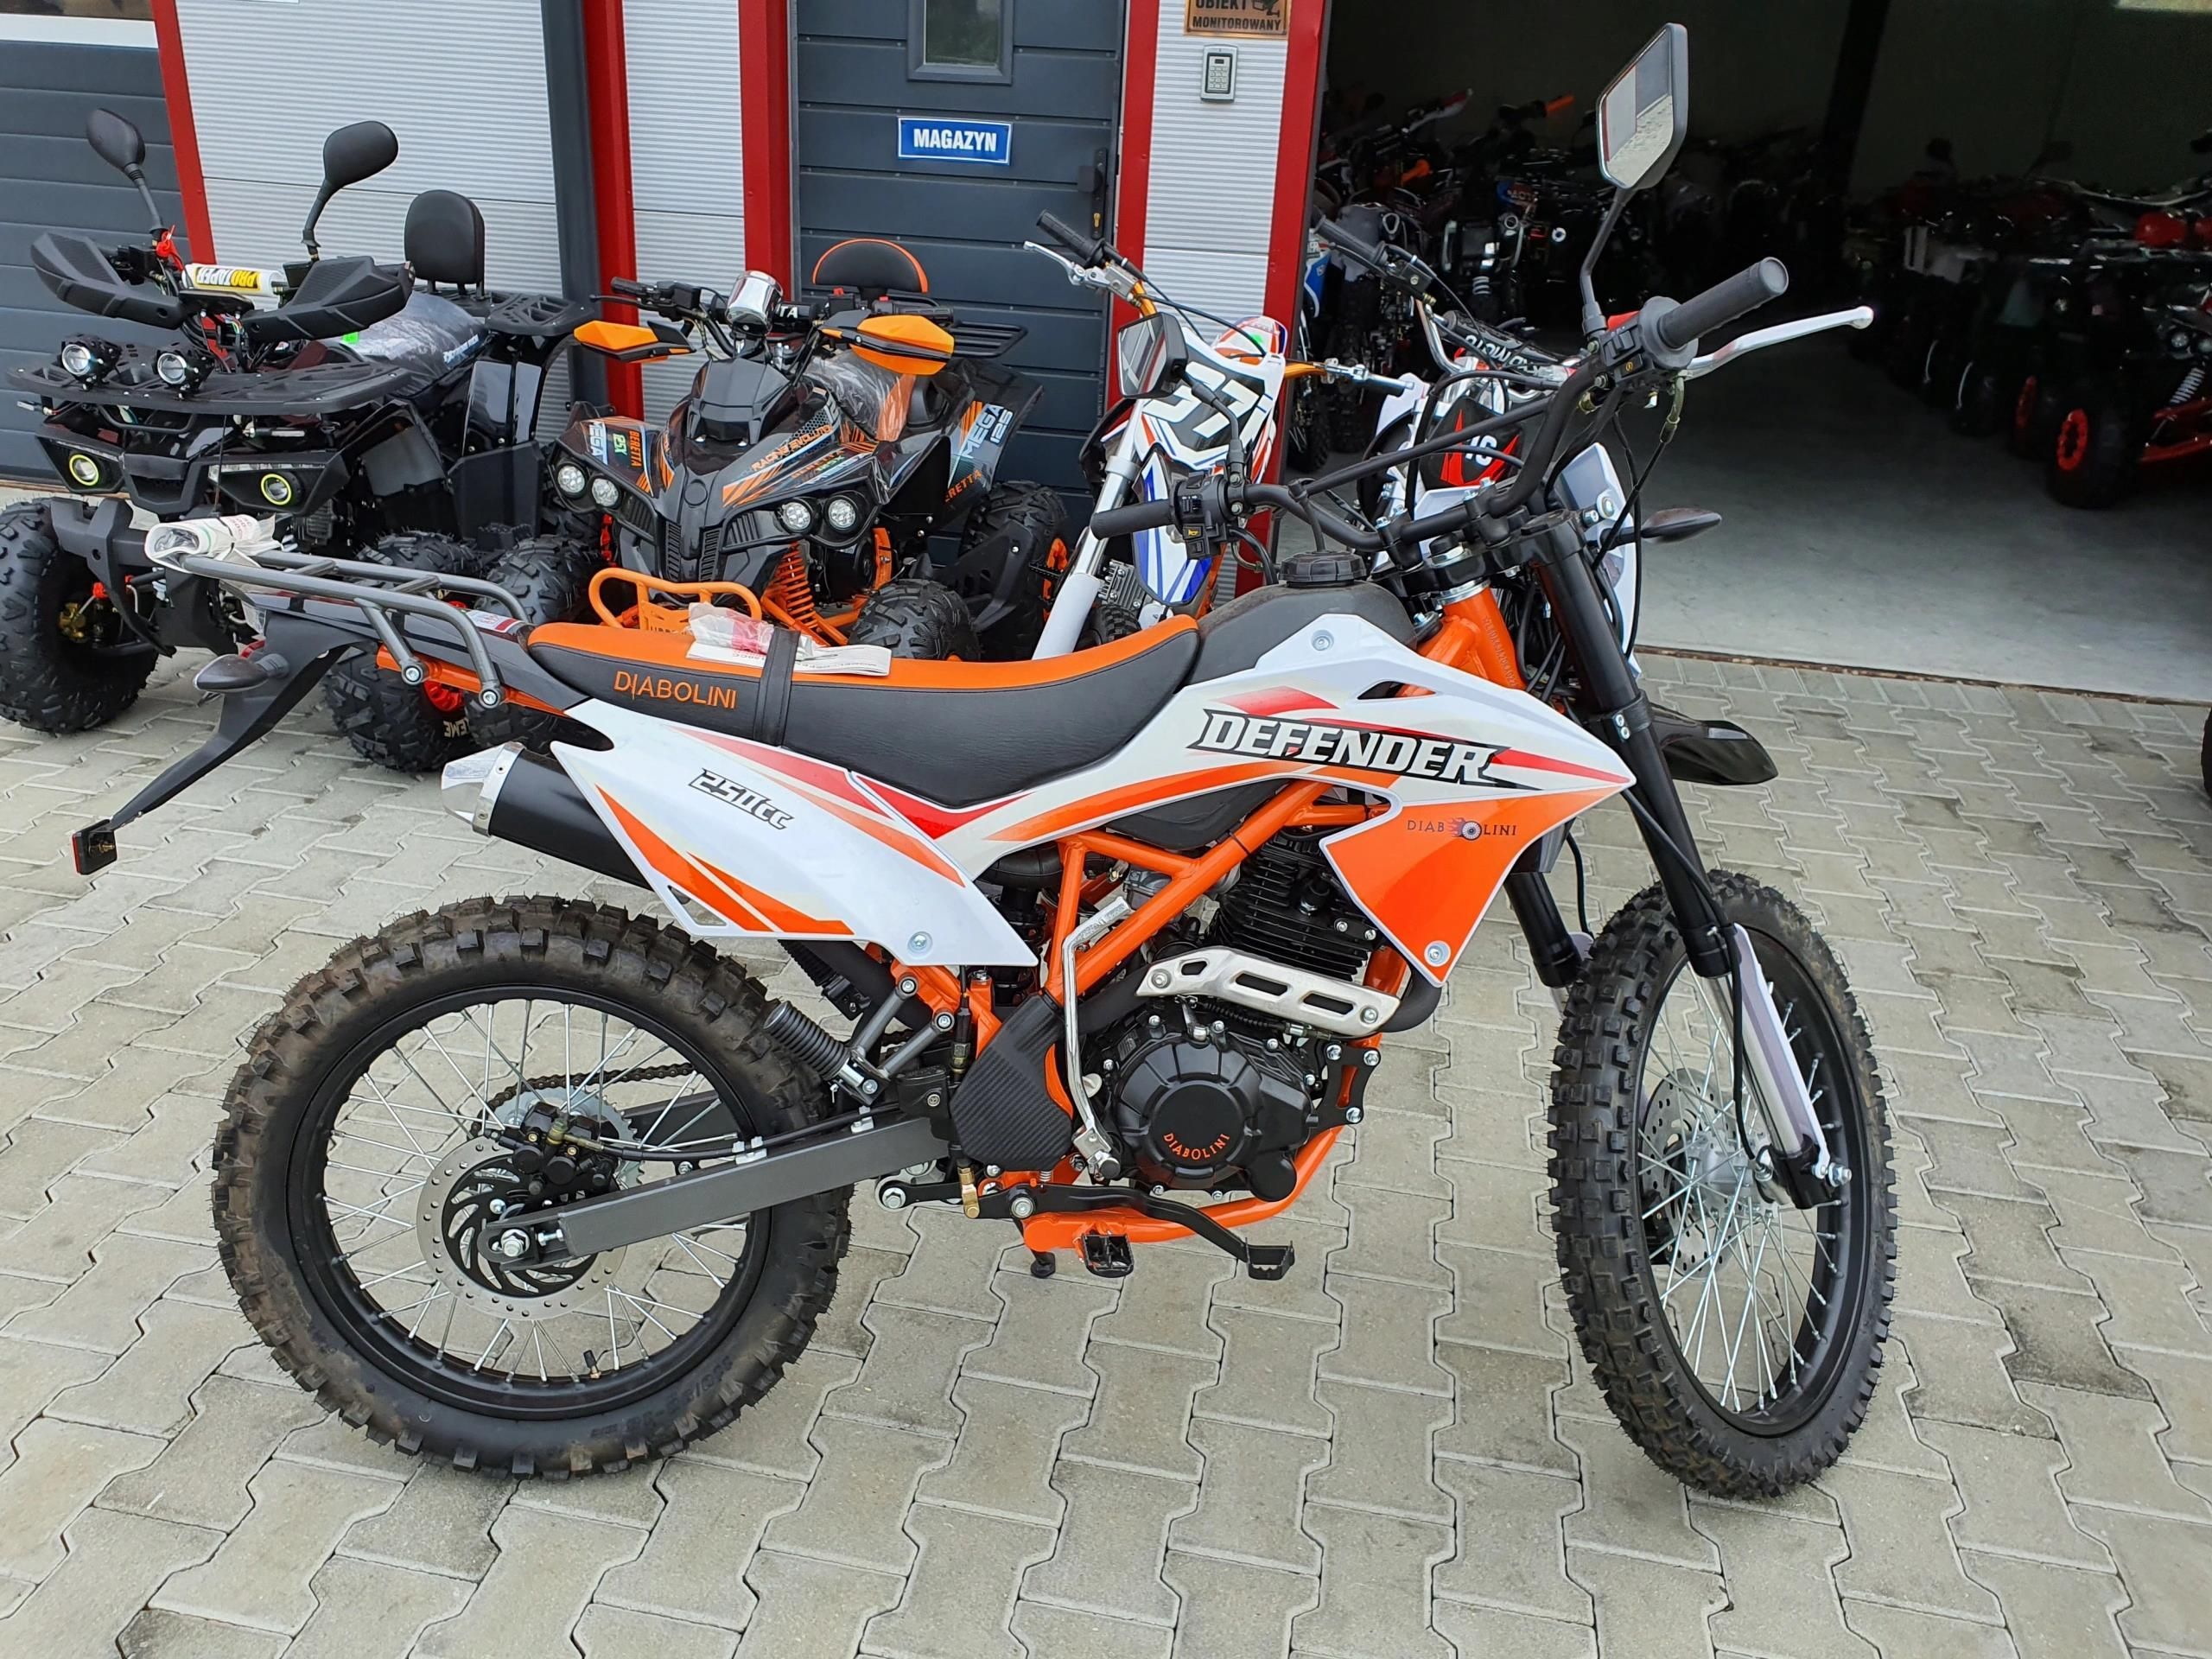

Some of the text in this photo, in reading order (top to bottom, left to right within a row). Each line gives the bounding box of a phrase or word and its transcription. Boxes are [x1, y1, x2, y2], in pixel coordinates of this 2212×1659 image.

[1192, 16, 1281, 31] MONITOROWANY
[913, 128, 997, 152] MAGAZYN
[961, 403, 1004, 459] MEGA
[989, 409, 1014, 443] 125
[628, 430, 643, 467] BERETTA
[613, 671, 738, 709] DIABOLINI
[1189, 709, 1510, 787] DEFENDER
[1163, 1132, 1230, 1160] DIABOLINI
